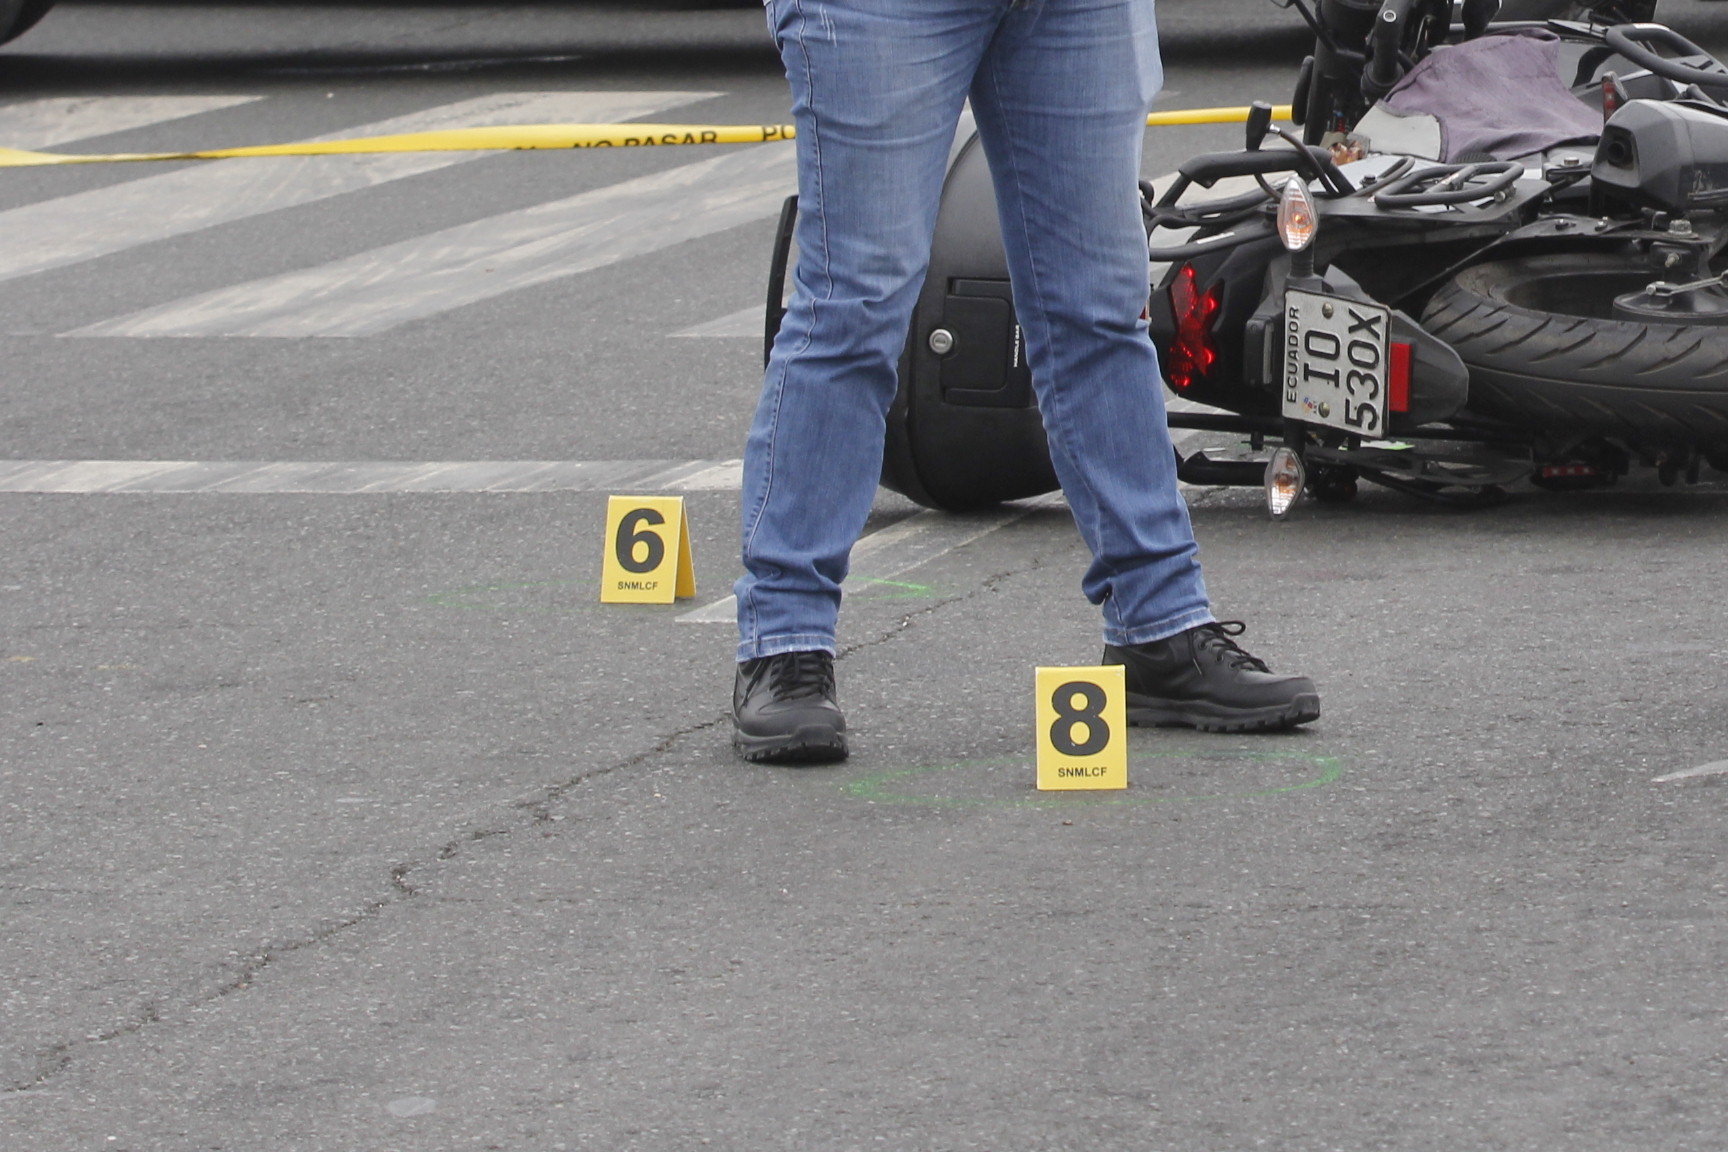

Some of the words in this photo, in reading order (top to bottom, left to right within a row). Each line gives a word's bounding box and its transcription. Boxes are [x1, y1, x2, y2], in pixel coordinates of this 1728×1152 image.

[1287, 306, 1299, 403] ECUADOR
[1345, 307, 1381, 431] 530X
[615, 508, 665, 574] 6
[617, 581, 658, 591] SNMLCF
[1050, 681, 1110, 757] 8
[1058, 767, 1107, 778] SNMLCF
